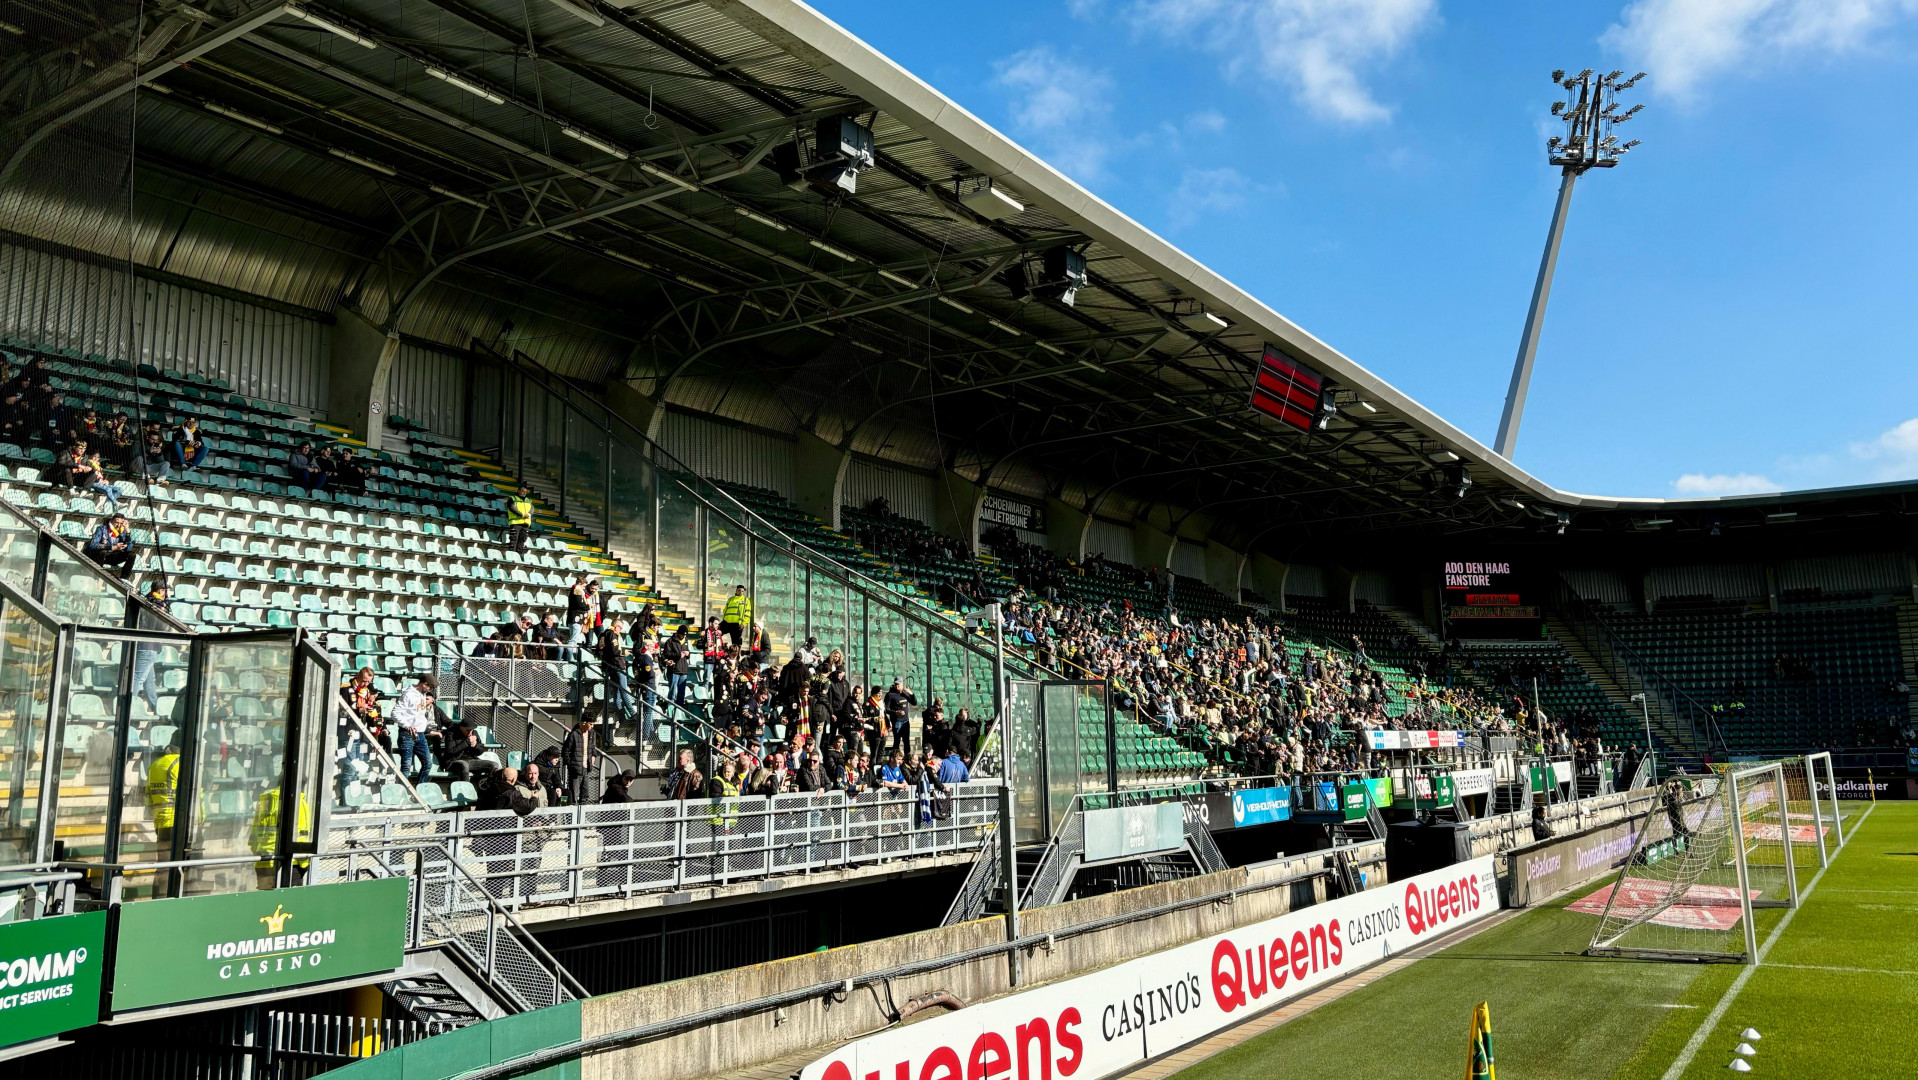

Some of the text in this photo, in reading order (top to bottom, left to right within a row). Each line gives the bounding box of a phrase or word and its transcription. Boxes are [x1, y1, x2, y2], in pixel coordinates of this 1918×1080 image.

[984, 496, 1031, 517] SCHOENMAKER
[980, 507, 1028, 528] AMILIETRIBUNE
[1445, 562, 1510, 574] ADO DEN HAAG
[1446, 574, 1490, 586] FANSTORE
[1815, 780, 1889, 791] Deadkamer
[1526, 852, 1561, 881] DeBadkamer
[207, 929, 336, 960] HOMMERSON
[219, 953, 322, 979] CASINO
[1102, 971, 1201, 1042] CASINO'S
[1211, 918, 1343, 1013] Queens
[1348, 902, 1401, 946] CASINO'S
[1405, 874, 1480, 936] Queens
[20, 984, 73, 1006] SERVICES
